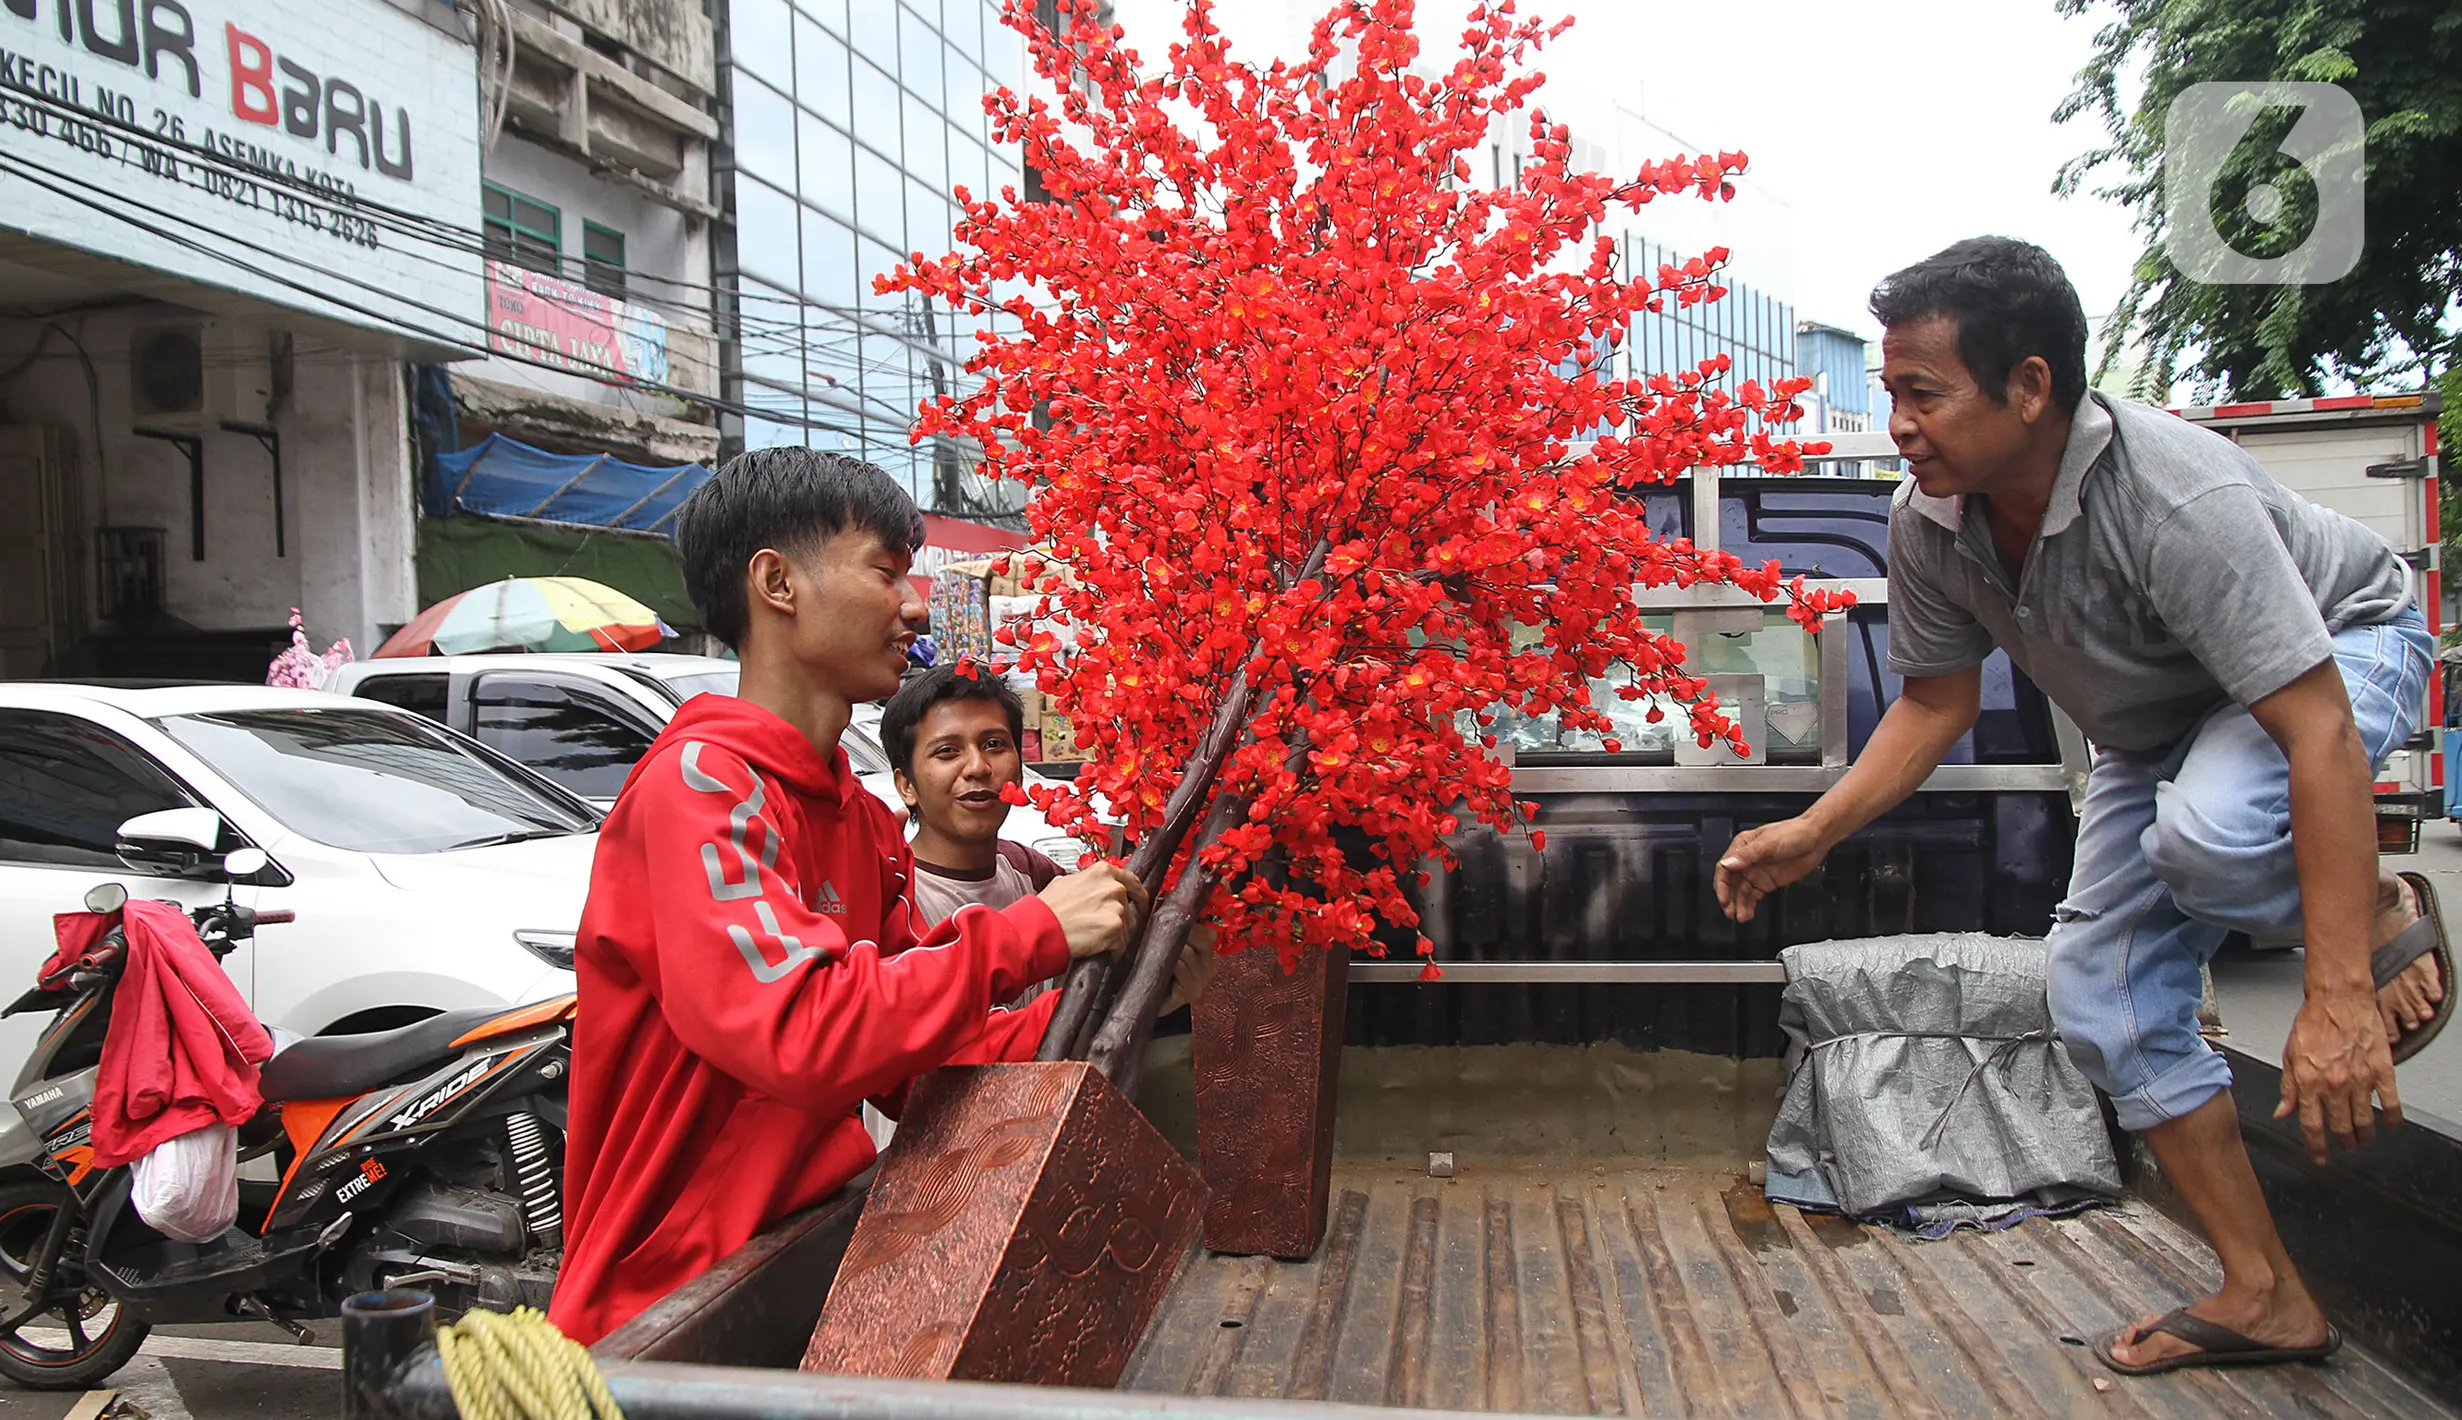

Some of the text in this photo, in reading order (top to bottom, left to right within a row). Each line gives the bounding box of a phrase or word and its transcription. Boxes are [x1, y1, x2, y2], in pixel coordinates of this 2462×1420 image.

[153, 107, 186, 143] 26
[203, 126, 297, 180] ASEMKA
[305, 165, 357, 206] KOTA
[140, 142, 179, 181] WA
[204, 167, 260, 209] 0821
[329, 213, 379, 250] 2626
[498, 294, 524, 315] TOKO
[500, 318, 615, 378] CIPTA JAYA
[24, 1087, 64, 1110] YAMAHA
[360, 1156, 379, 1172] RIDE
